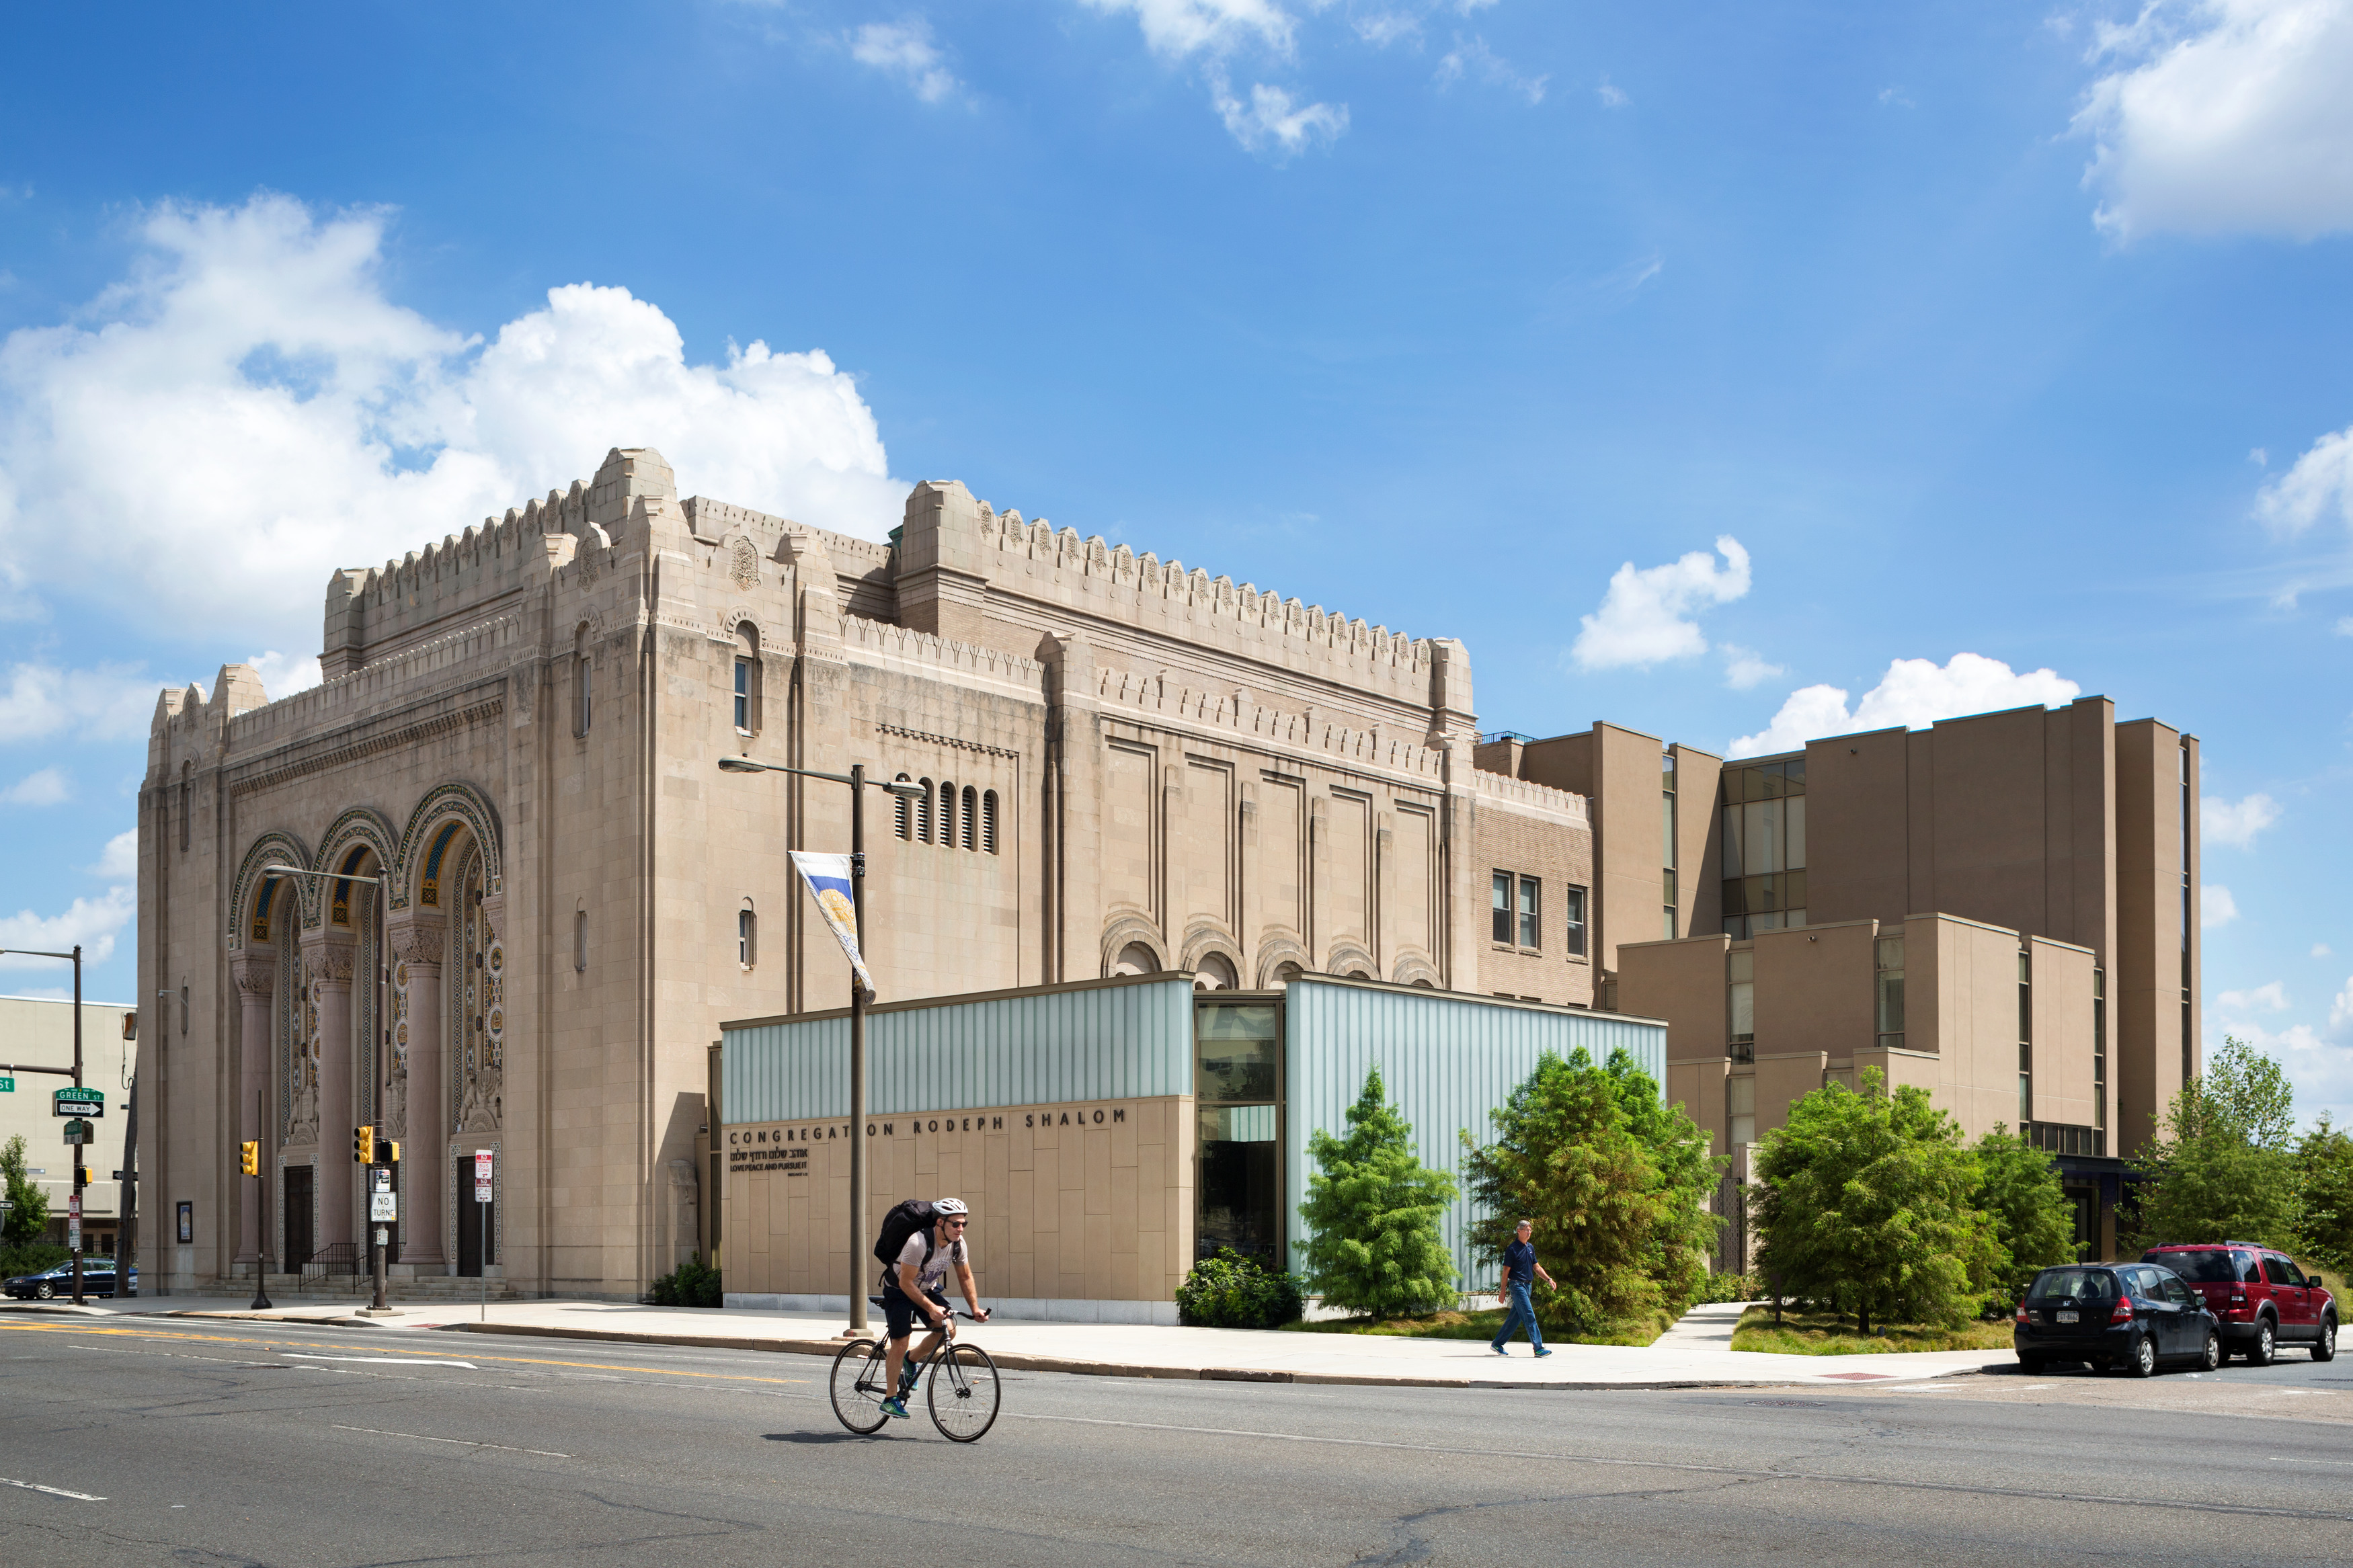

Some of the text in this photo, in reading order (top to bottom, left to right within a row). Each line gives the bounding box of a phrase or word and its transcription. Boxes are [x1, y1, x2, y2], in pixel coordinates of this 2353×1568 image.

[0, 1079, 9, 1089] St
[59, 1091, 89, 1100] GREEN
[729, 1109, 1125, 1145] CONGREGATON RODEPH SHALOM
[730, 1148, 748, 1161] שלום
[768, 1146, 788, 1159] שלום
[730, 1164, 745, 1172] LOVE
[745, 1163, 764, 1171] PEACE
[764, 1163, 778, 1171] AND
[778, 1161, 801, 1170] PURSUE
[378, 1198, 389, 1206] NO
